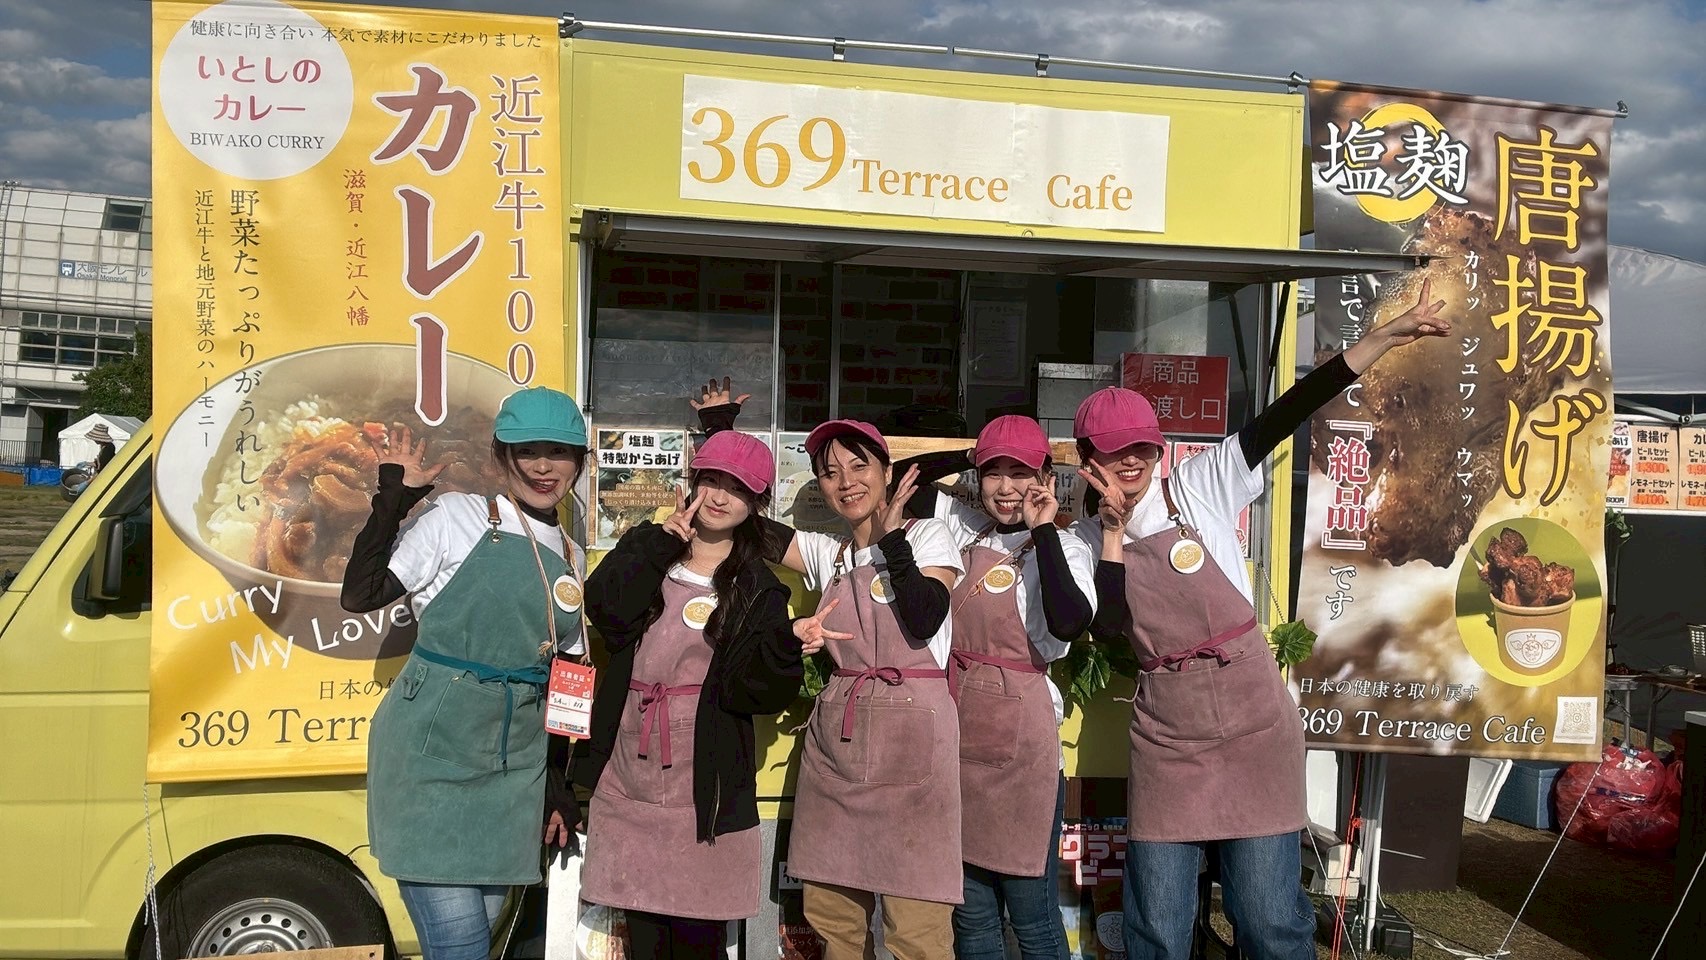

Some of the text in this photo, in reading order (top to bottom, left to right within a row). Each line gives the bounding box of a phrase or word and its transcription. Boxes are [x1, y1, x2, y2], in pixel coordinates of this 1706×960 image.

[190, 19, 542, 49] 健康に向き合い 本気で素材にこだわりました
[199, 55, 321, 84] いとしの
[213, 93, 306, 121] カレー
[190, 132, 325, 150] BIWAKO CURRY
[687, 107, 1133, 211] 369 Terrace Cafe
[1319, 120, 1468, 204] 塩麹
[372, 63, 482, 424] カレー
[491, 74, 545, 390] 近江牛100
[343, 168, 370, 327] 滋賀・近江八幡
[77, 262, 148, 277] 大阪モノレール
[194, 189, 216, 448] 近江牛と地元野菜のハーモニー
[1491, 129, 1606, 506] 唐揚げ
[230, 189, 261, 512] 野菜たっぷりがうれしい
[1153, 359, 1199, 384] 商品
[1456, 250, 1481, 508] カリッ ジュワッ ウマッ
[1186, 445, 1210, 454] キッチ
[1637, 430, 1669, 444] 唐揚げ
[1637, 447, 1670, 457] ビールセット
[602, 452, 680, 465] 特製からあげ
[1688, 449, 1706, 458] ビール
[1631, 479, 1675, 488] レモネードセット
[167, 581, 284, 632] Curry
[229, 603, 411, 675] My Love
[319, 679, 395, 701] 日本の
[1300, 678, 1480, 702] 日本の健康を取り戻す
[178, 709, 373, 748] 369 Terr
[1355, 710, 1472, 742] Terrace
[1482, 715, 1546, 745] Cafe
